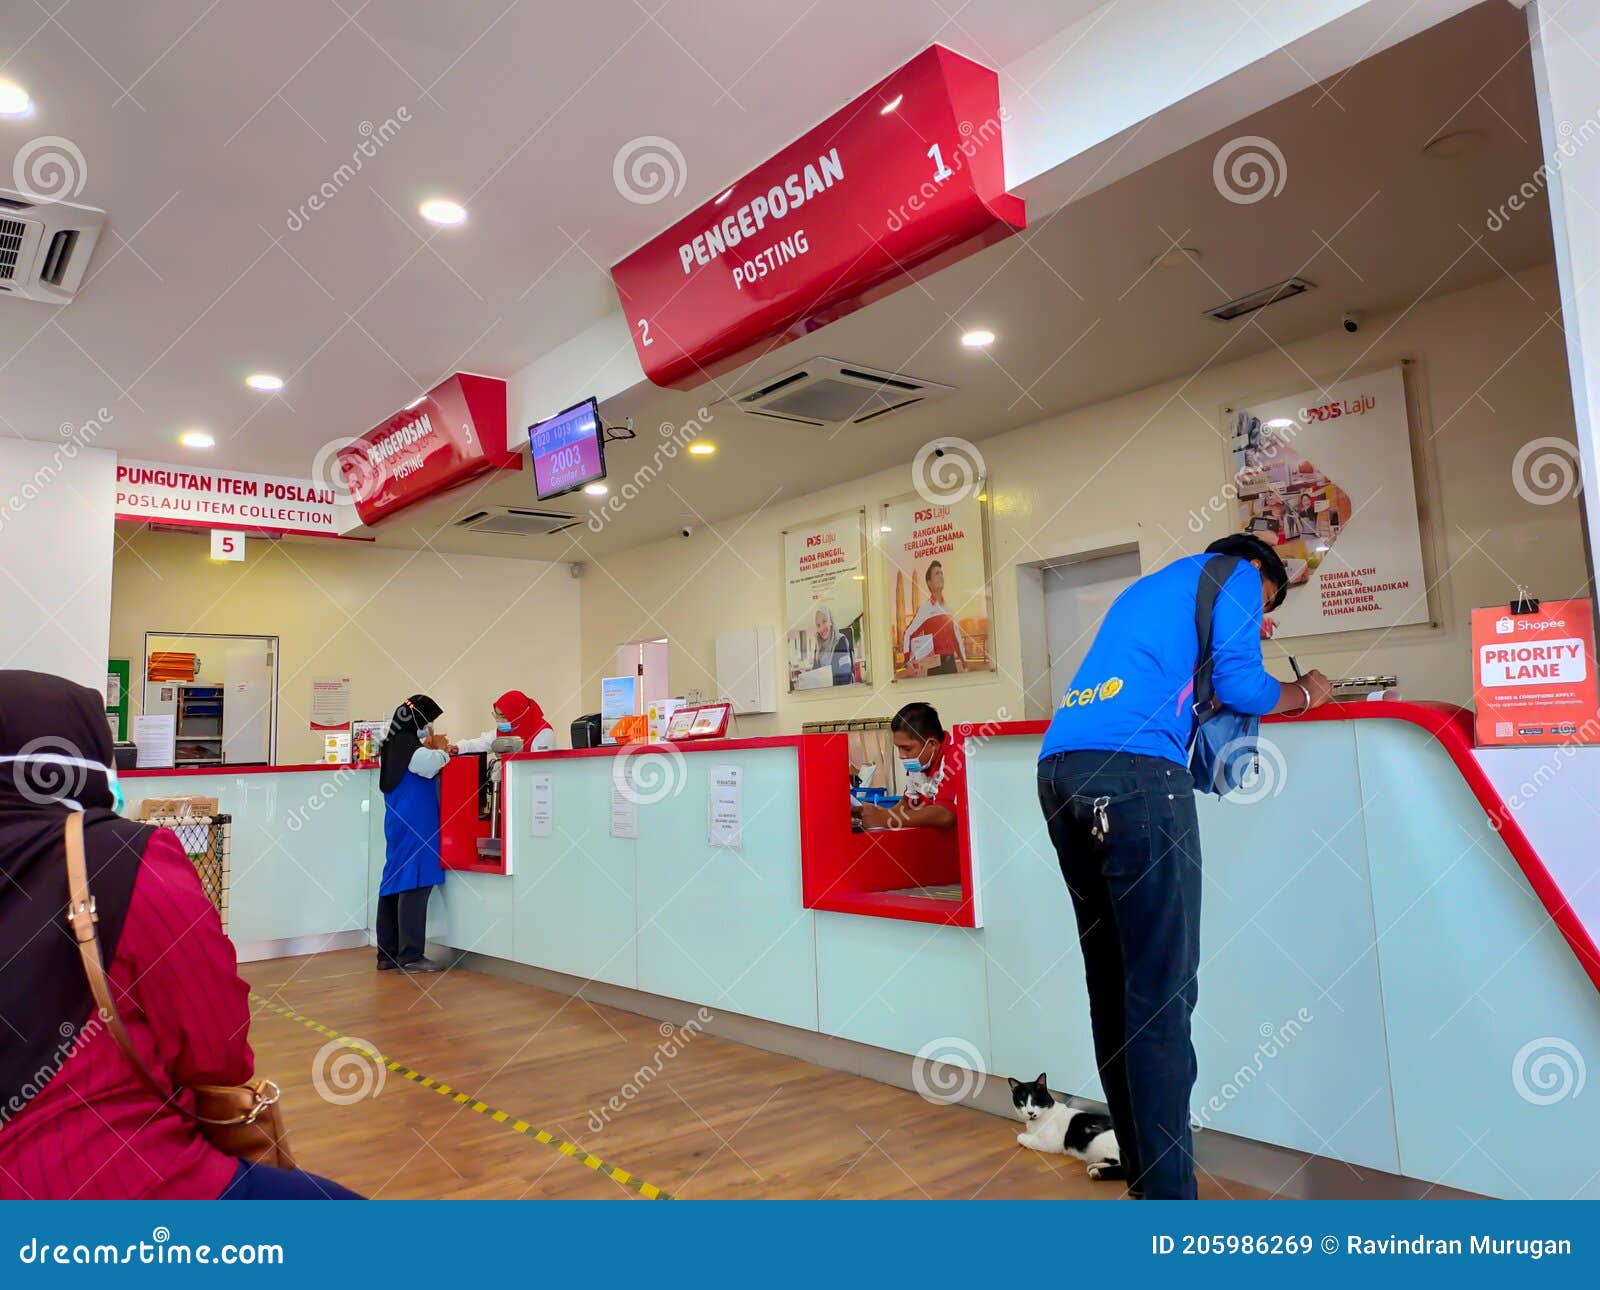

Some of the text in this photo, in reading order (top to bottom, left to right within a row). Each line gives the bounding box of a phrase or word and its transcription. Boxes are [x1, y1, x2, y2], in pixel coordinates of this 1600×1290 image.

[927, 143, 953, 183] 1
[678, 148, 845, 274] PENGEPOSAN
[732, 229, 810, 290] POSTING
[637, 318, 654, 346] 2
[1344, 395, 1376, 416] Laju
[367, 413, 433, 466] PENGEPOSAN
[462, 423, 473, 445] 3
[393, 454, 424, 481] POSTING
[550, 445, 581, 474] 2003
[115, 465, 336, 505] PUNGUTAN ITEM POSLAJU
[115, 492, 332, 525] POSLAJU ITEM COLLECTION
[914, 505, 951, 524] POS Laju
[912, 522, 953, 539] RANGKAIAN
[222, 537, 234, 553] 5
[806, 535, 821, 548] POS
[904, 530, 965, 552] TERLUAS, JENAMA
[914, 543, 954, 559] DIPERCAYAI
[799, 554, 816, 564] ANDA
[1320, 567, 1376, 582] TERIMA KASIH
[1320, 579, 1362, 590] MALAYSIA,
[1321, 581, 1409, 599] KERANA MENJADIKAN
[1322, 595, 1374, 608] KAMI KURIER
[1323, 603, 1382, 616] PILIHAN ANDA.
[1517, 619, 1565, 632] Shopee
[1485, 644, 1580, 665] PRIORITY
[1505, 663, 1560, 680] LANE
